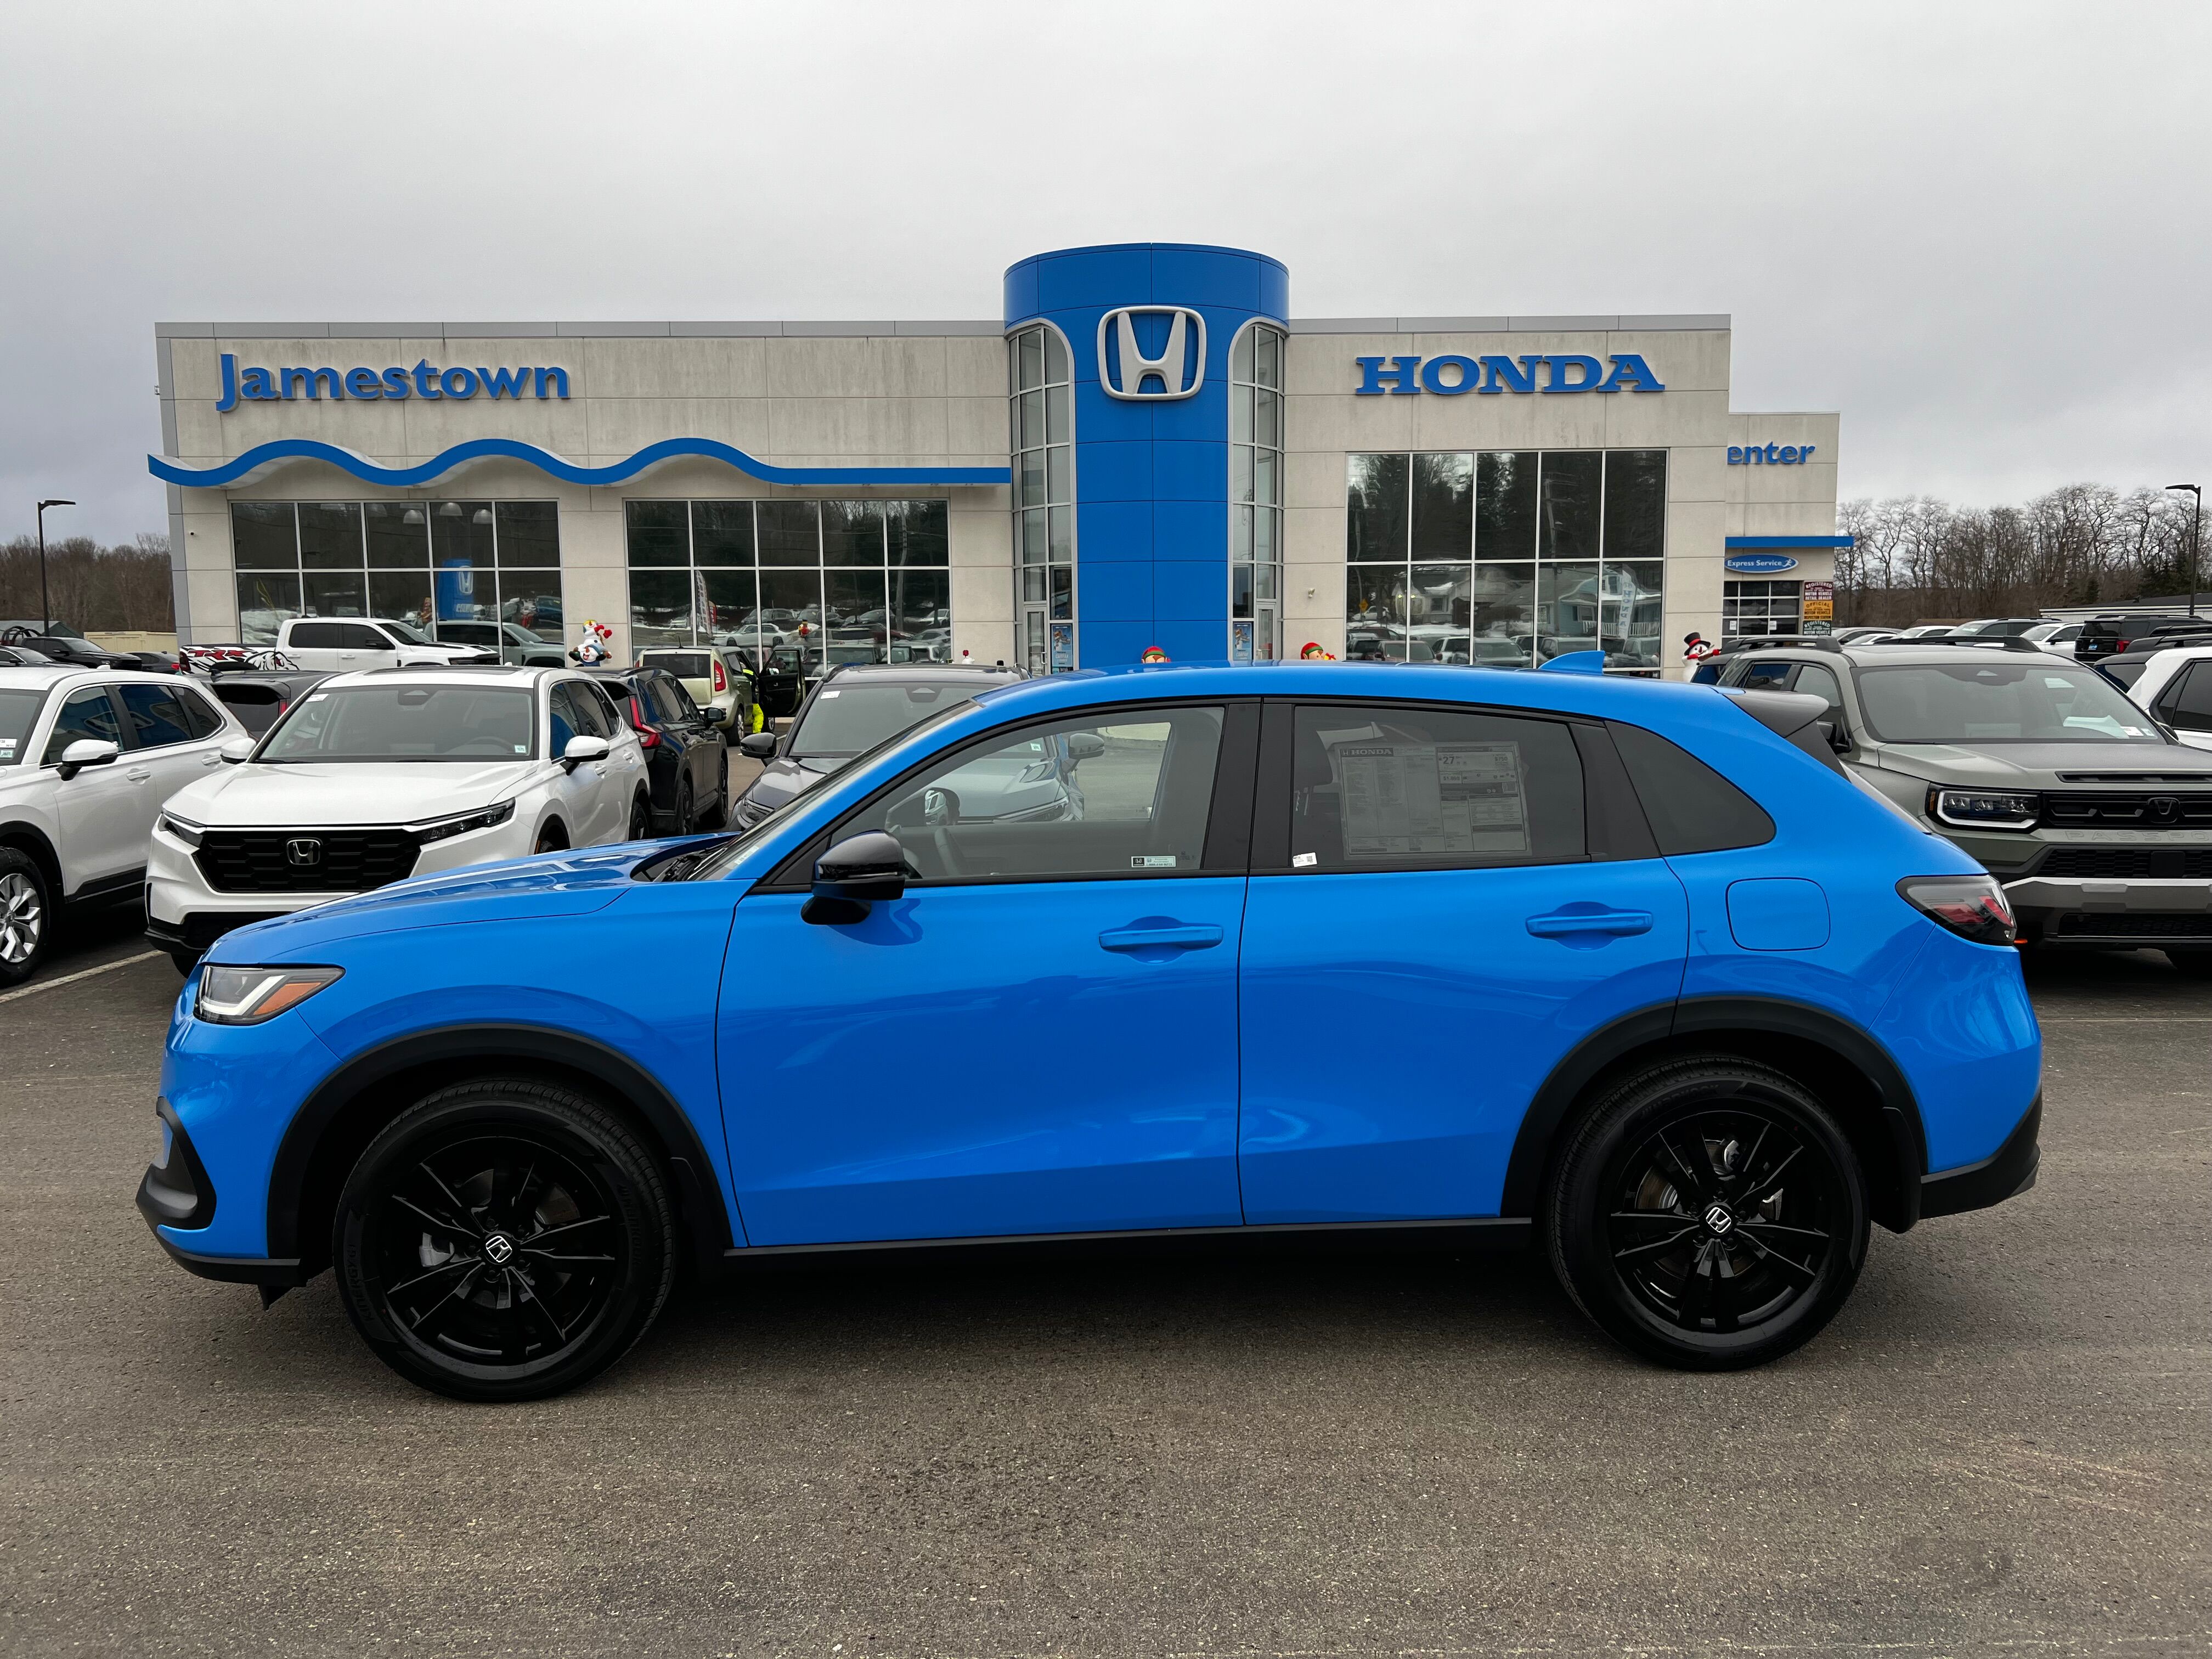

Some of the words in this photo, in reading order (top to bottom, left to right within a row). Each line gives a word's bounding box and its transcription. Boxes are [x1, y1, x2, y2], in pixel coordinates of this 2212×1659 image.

[216, 354, 571, 412] Jamestown
[1356, 355, 1665, 394] HONDA
[1727, 441, 1815, 465] enter
[188, 650, 248, 661] TRX
[1443, 756, 1454, 764] 27
